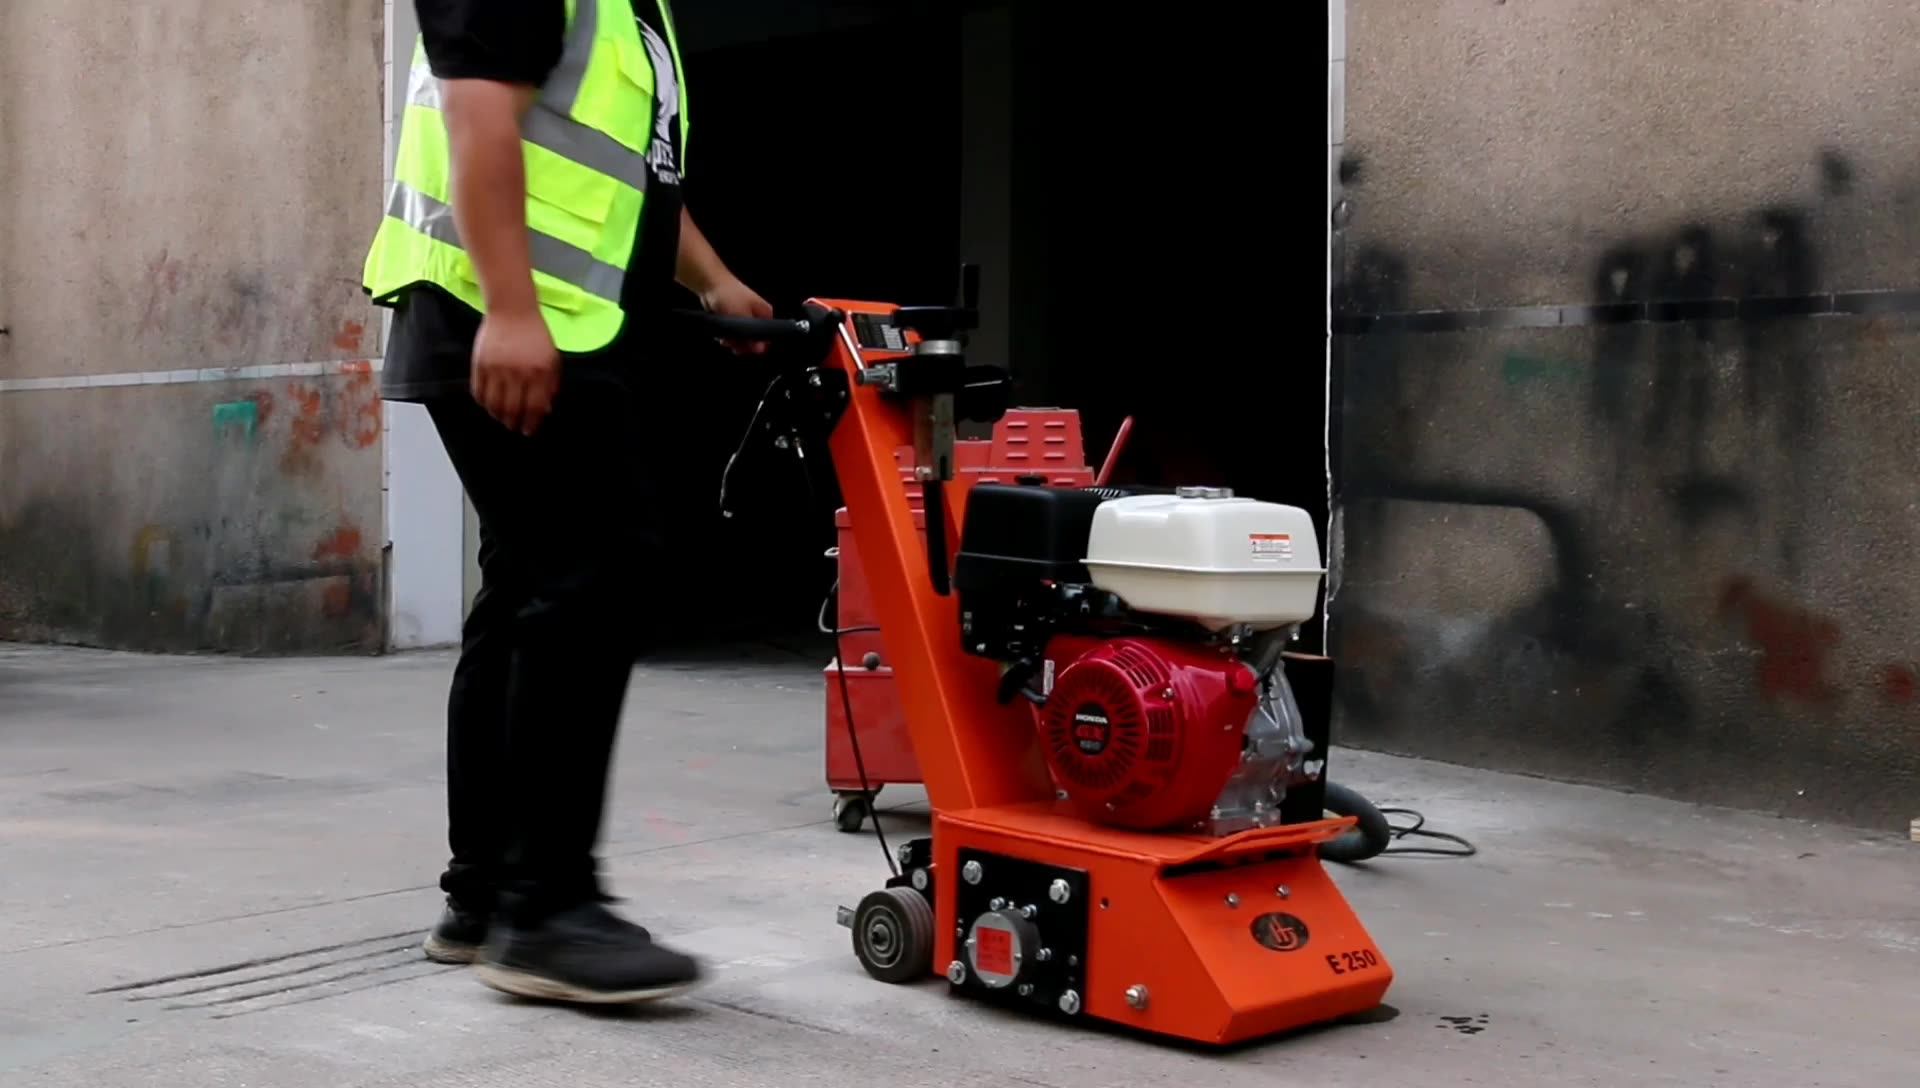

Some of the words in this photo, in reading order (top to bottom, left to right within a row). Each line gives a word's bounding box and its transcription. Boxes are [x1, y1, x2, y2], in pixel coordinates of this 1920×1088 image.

[1075, 714, 1108, 724] HONDA
[1326, 954, 1344, 975] E
[1343, 949, 1377, 971] 250
